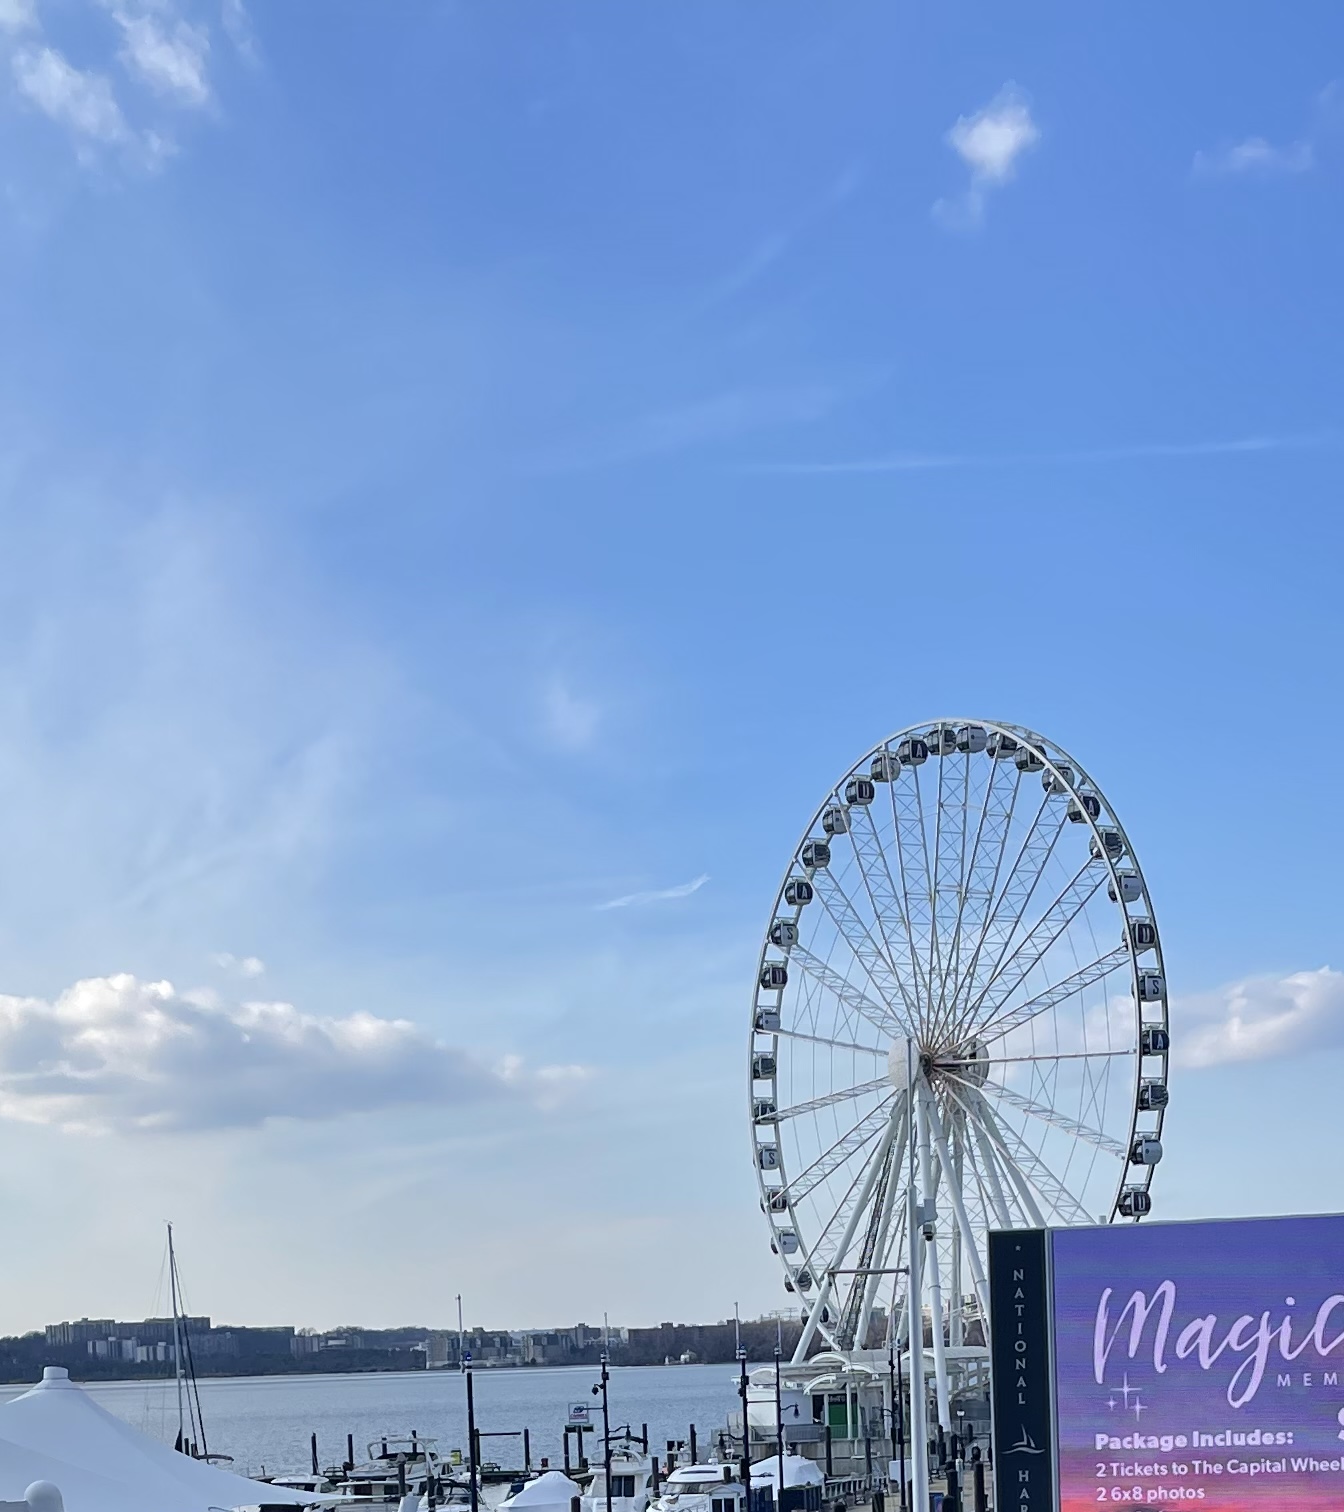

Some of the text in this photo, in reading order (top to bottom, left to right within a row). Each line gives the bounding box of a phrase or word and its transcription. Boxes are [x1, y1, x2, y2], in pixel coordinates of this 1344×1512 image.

[1013, 1268, 1027, 1404] NATIONAL
[1095, 1429, 1294, 1452] Package Includes:
[1095, 1457, 1344, 1478] 2 Tickets to The Capital Wheel
[1096, 1485, 1205, 1504] 2 6x8 photos
